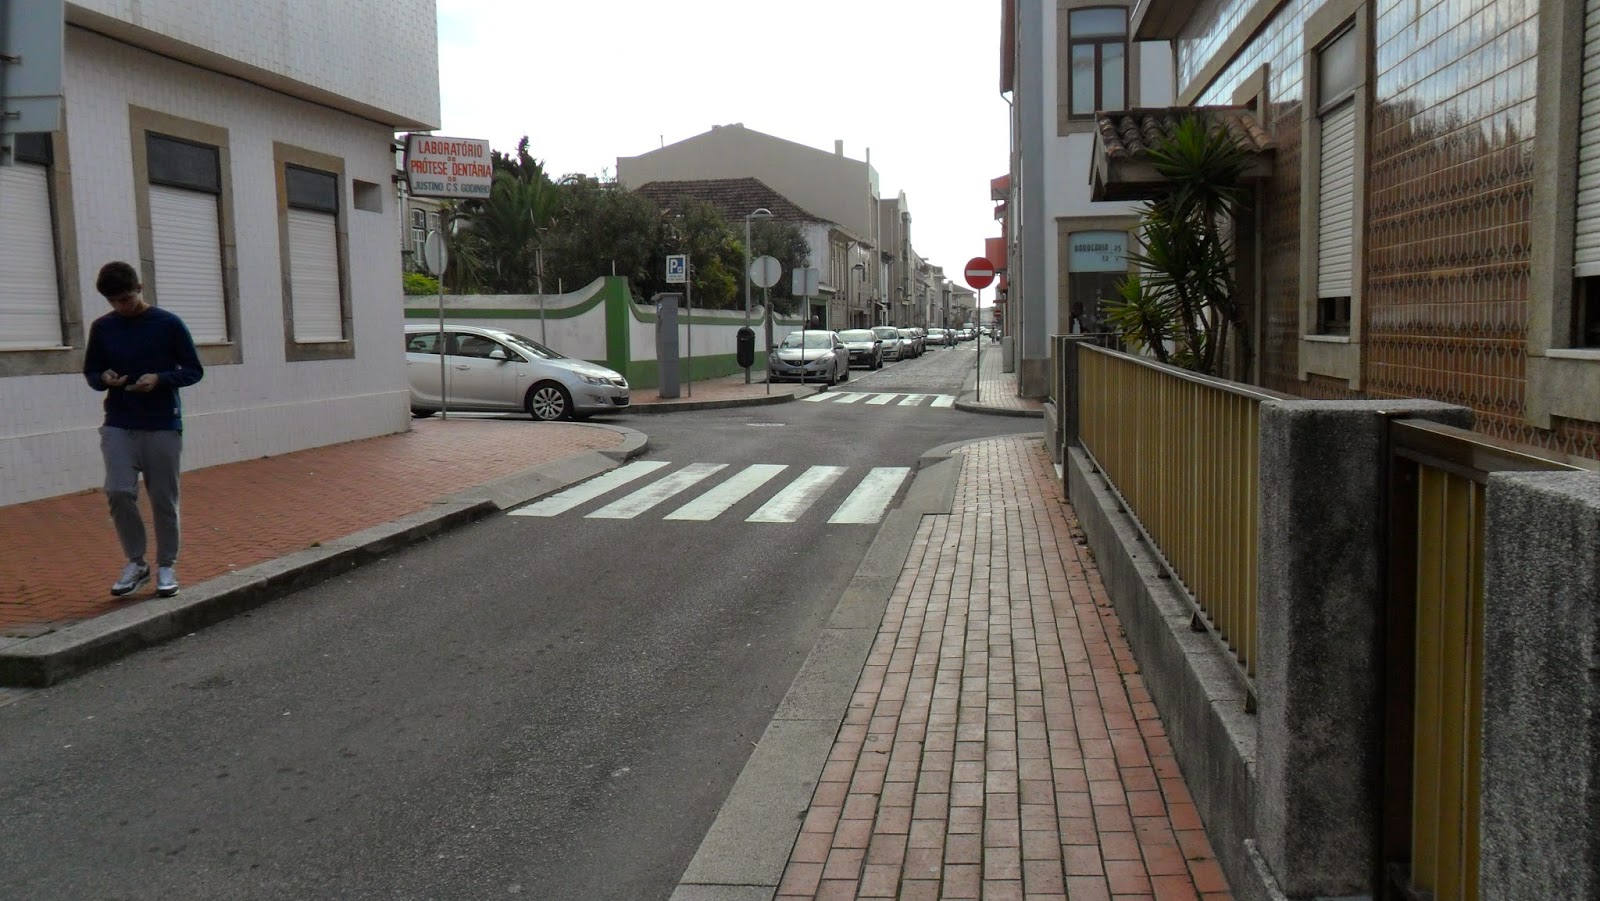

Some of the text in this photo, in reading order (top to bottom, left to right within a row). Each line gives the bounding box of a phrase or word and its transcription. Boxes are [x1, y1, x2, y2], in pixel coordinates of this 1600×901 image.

[418, 140, 483, 158] LABORATÓRIO
[411, 158, 491, 177] PRÓTESE DENTÁRIA
[414, 182, 443, 192] JUSTINO
[453, 183, 458, 192] S
[461, 183, 490, 193] GODINHO
